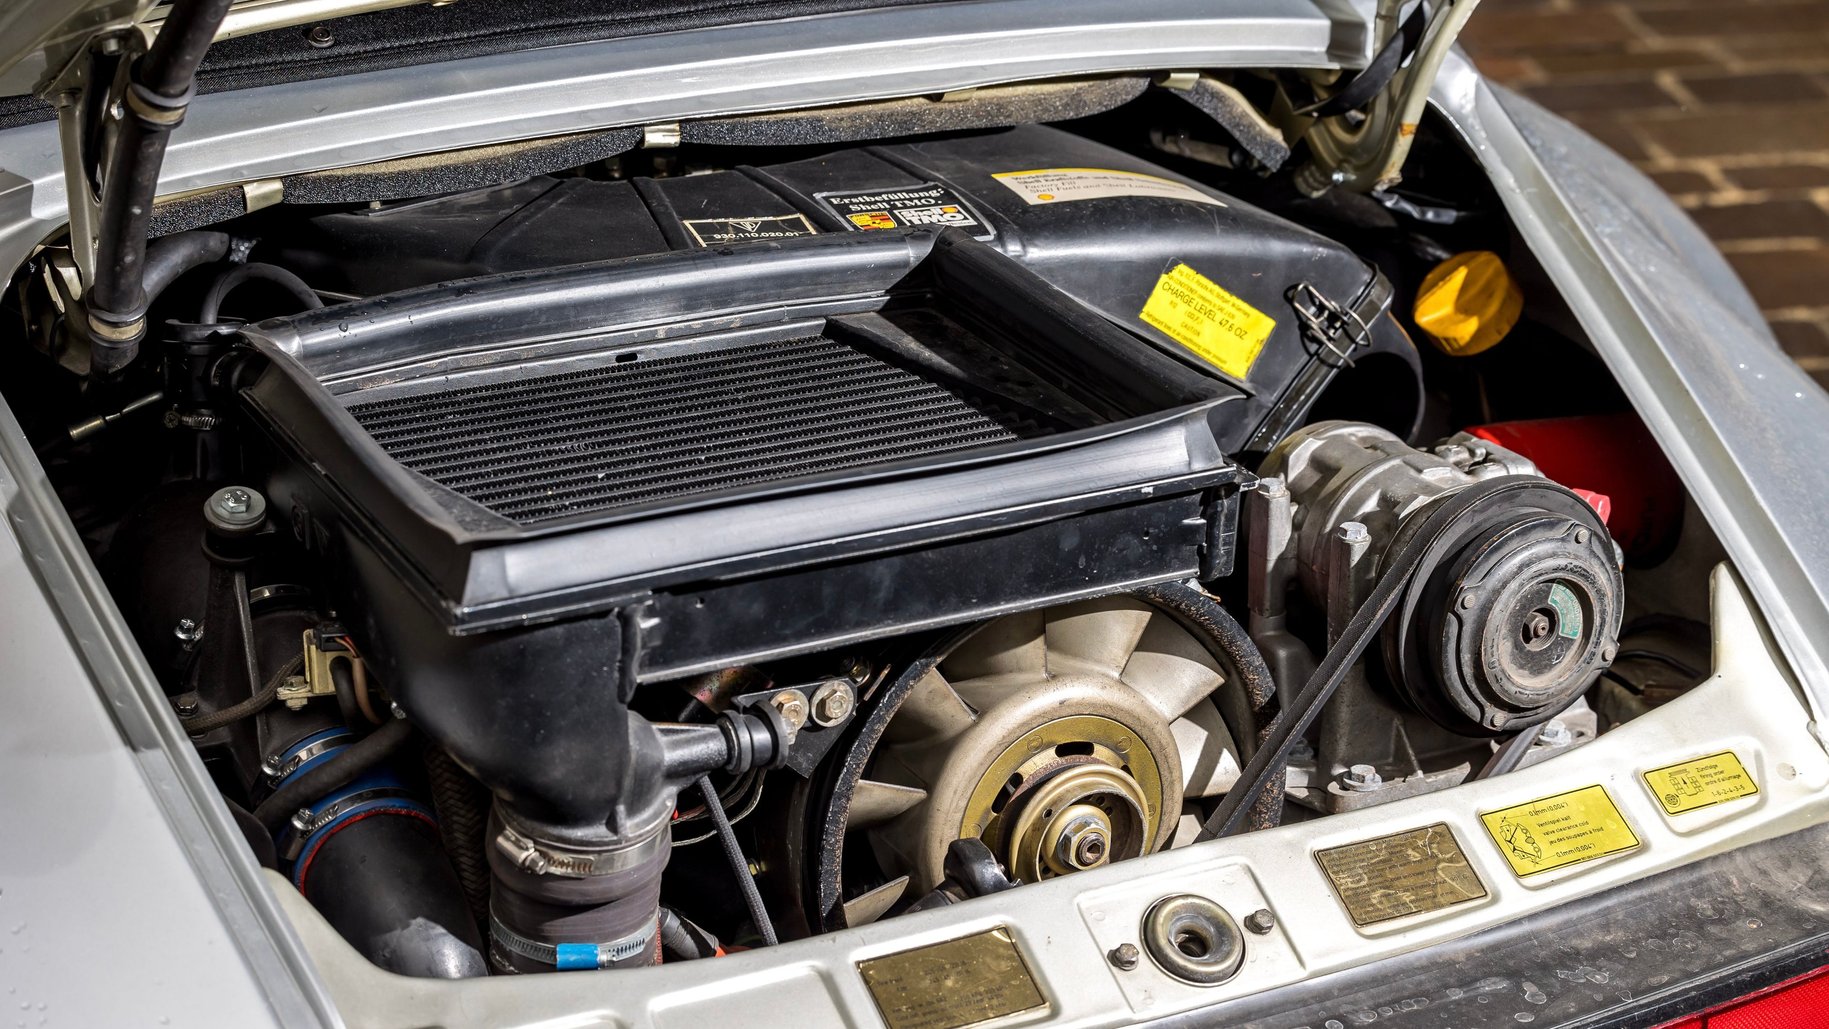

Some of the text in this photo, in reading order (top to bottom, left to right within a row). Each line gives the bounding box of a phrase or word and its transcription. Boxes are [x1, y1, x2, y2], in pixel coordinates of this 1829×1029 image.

[829, 188, 944, 205] Erstbefüllung:
[849, 202, 890, 211] Shell
[900, 207, 944, 218] Shell
[905, 212, 965, 225] TMO
[713, 231, 799, 239] 930.110.020.01
[1162, 281, 1194, 307] CHARGE
[1194, 301, 1217, 322] LEVEL
[1218, 317, 1233, 332] 47.6
[1234, 328, 1248, 340] OZ
[1537, 819, 1561, 828] Ventilspiel
[1556, 824, 1578, 833] clearance
[1566, 832, 1588, 840] soupapes
